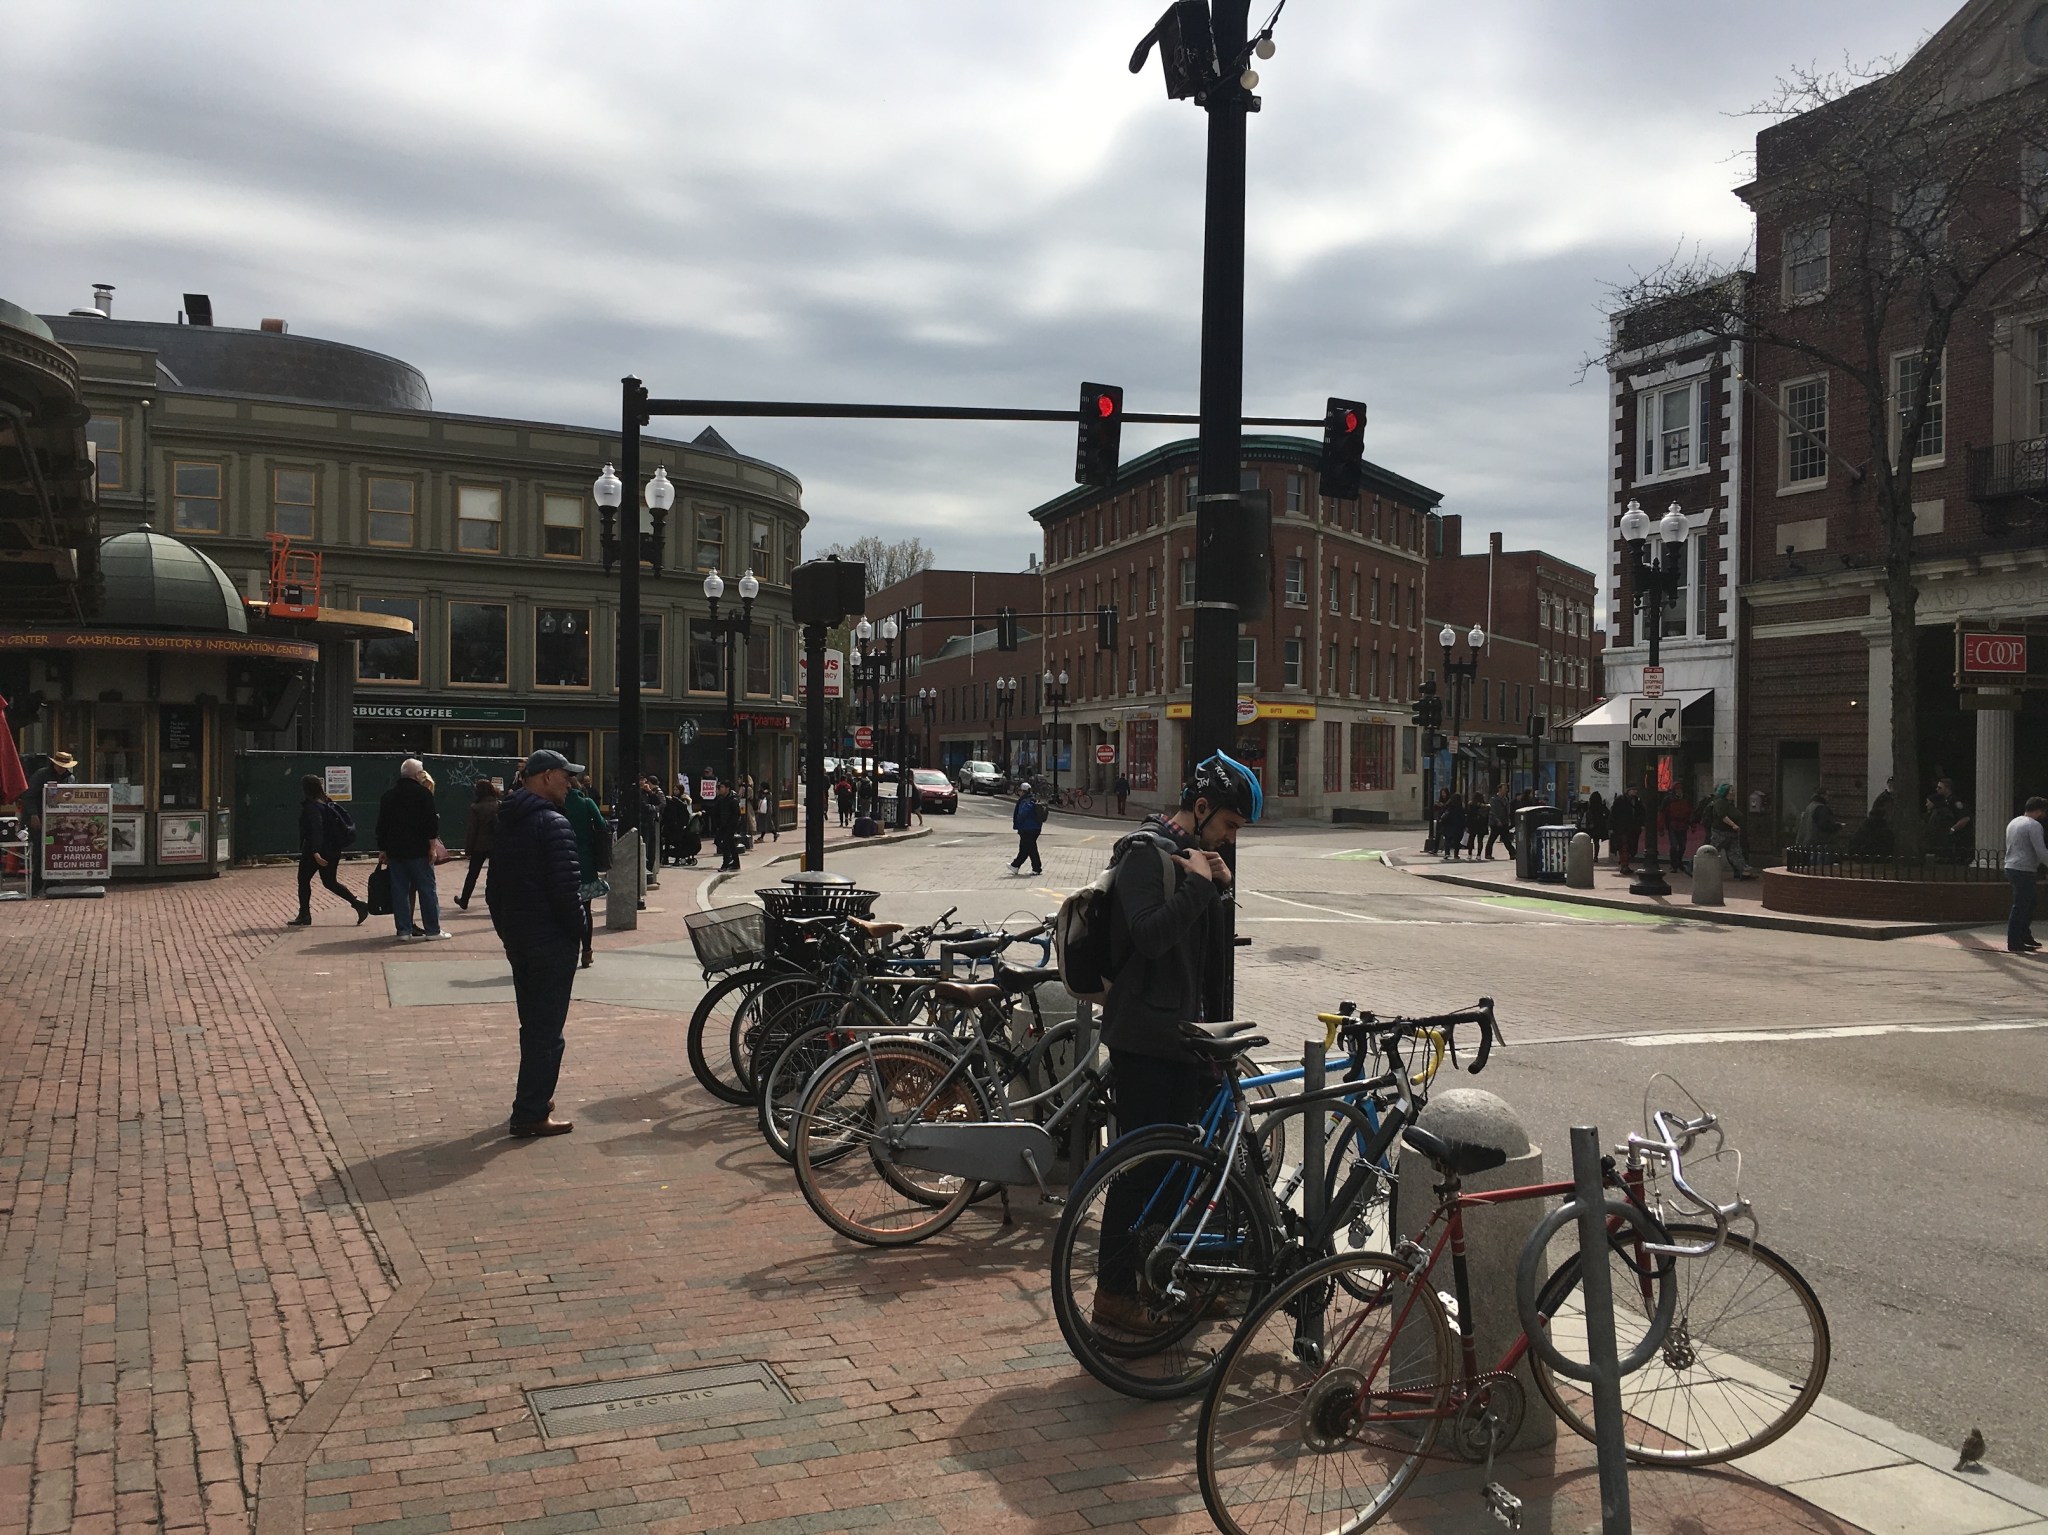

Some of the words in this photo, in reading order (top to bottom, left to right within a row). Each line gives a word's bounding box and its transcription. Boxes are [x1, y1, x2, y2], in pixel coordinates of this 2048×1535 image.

[8, 635, 49, 645] CENTER
[66, 635, 141, 646] CAMBRIDGE
[145, 637, 202, 648] VISITOR'S
[206, 639, 275, 653] INFORMATION
[276, 645, 303, 655] CENTER
[1975, 641, 2024, 665] COOP
[823, 659, 839, 670] VS
[353, 706, 401, 716] RBUCKS
[405, 708, 453, 718] COFFEE
[1632, 733, 1653, 741] ONLY
[1657, 733, 1678, 742] ONLY
[605, 1390, 714, 1411] ELECTRIC
